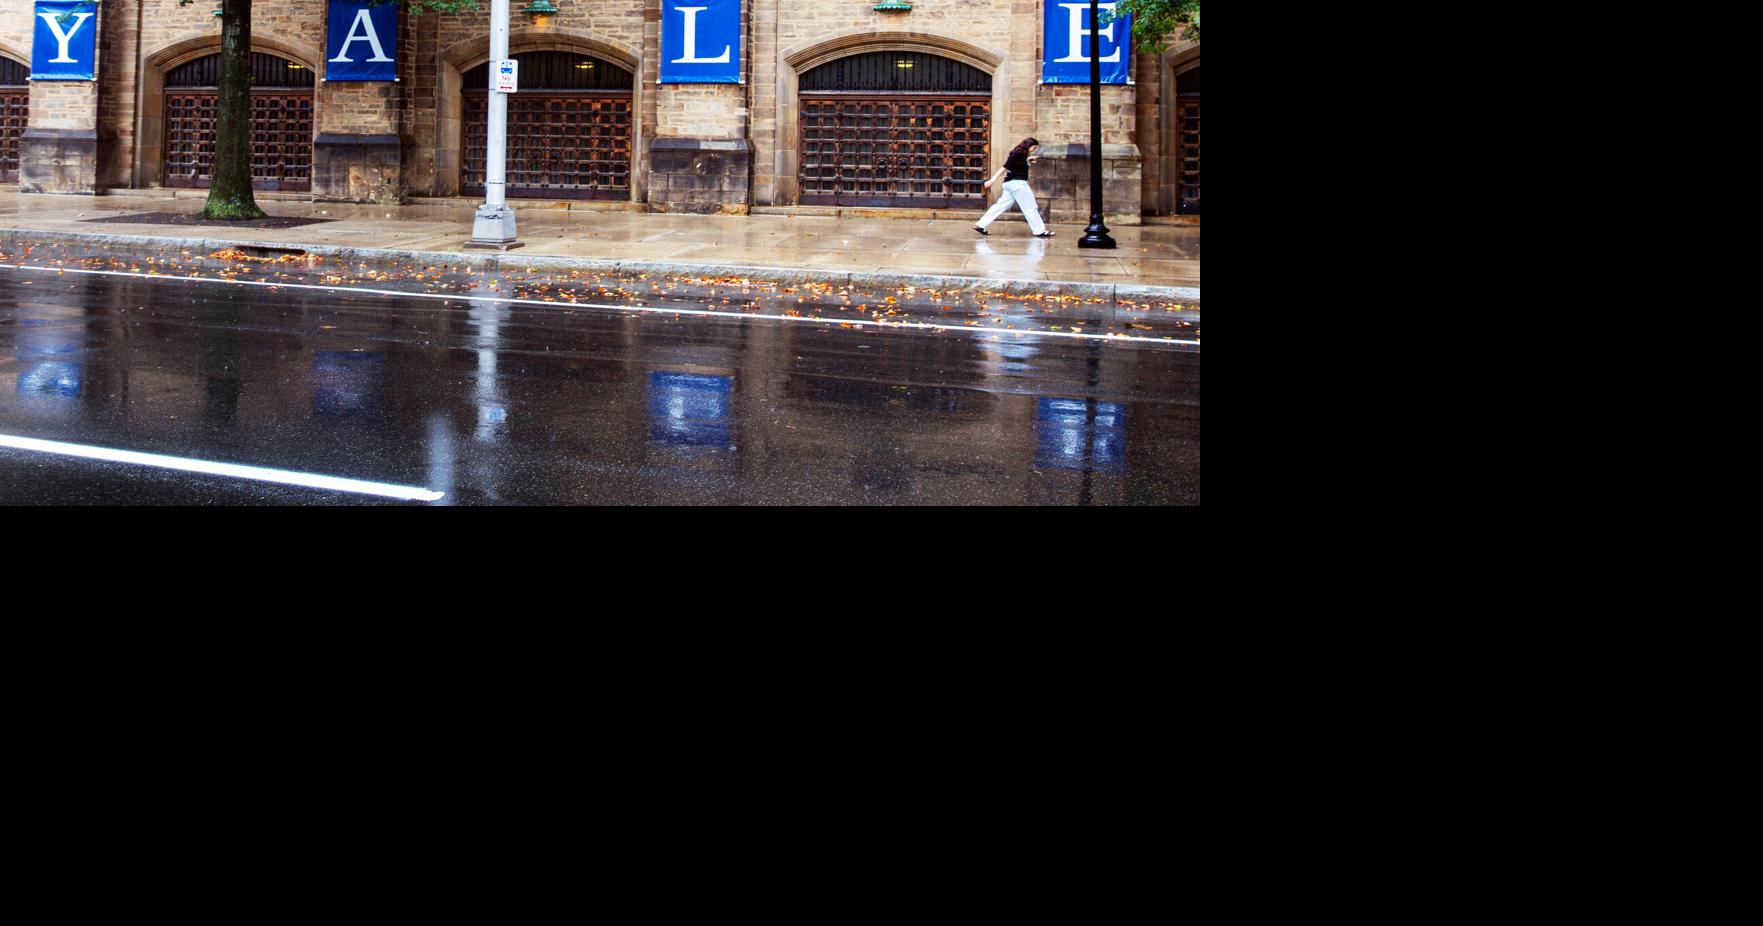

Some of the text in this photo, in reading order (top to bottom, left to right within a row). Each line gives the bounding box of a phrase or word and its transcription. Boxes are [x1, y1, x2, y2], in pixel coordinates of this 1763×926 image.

[37, 12, 93, 62] Y
[329, 9, 394, 61] A
[672, 7, 729, 63] L
[1054, 3, 1121, 62] E
